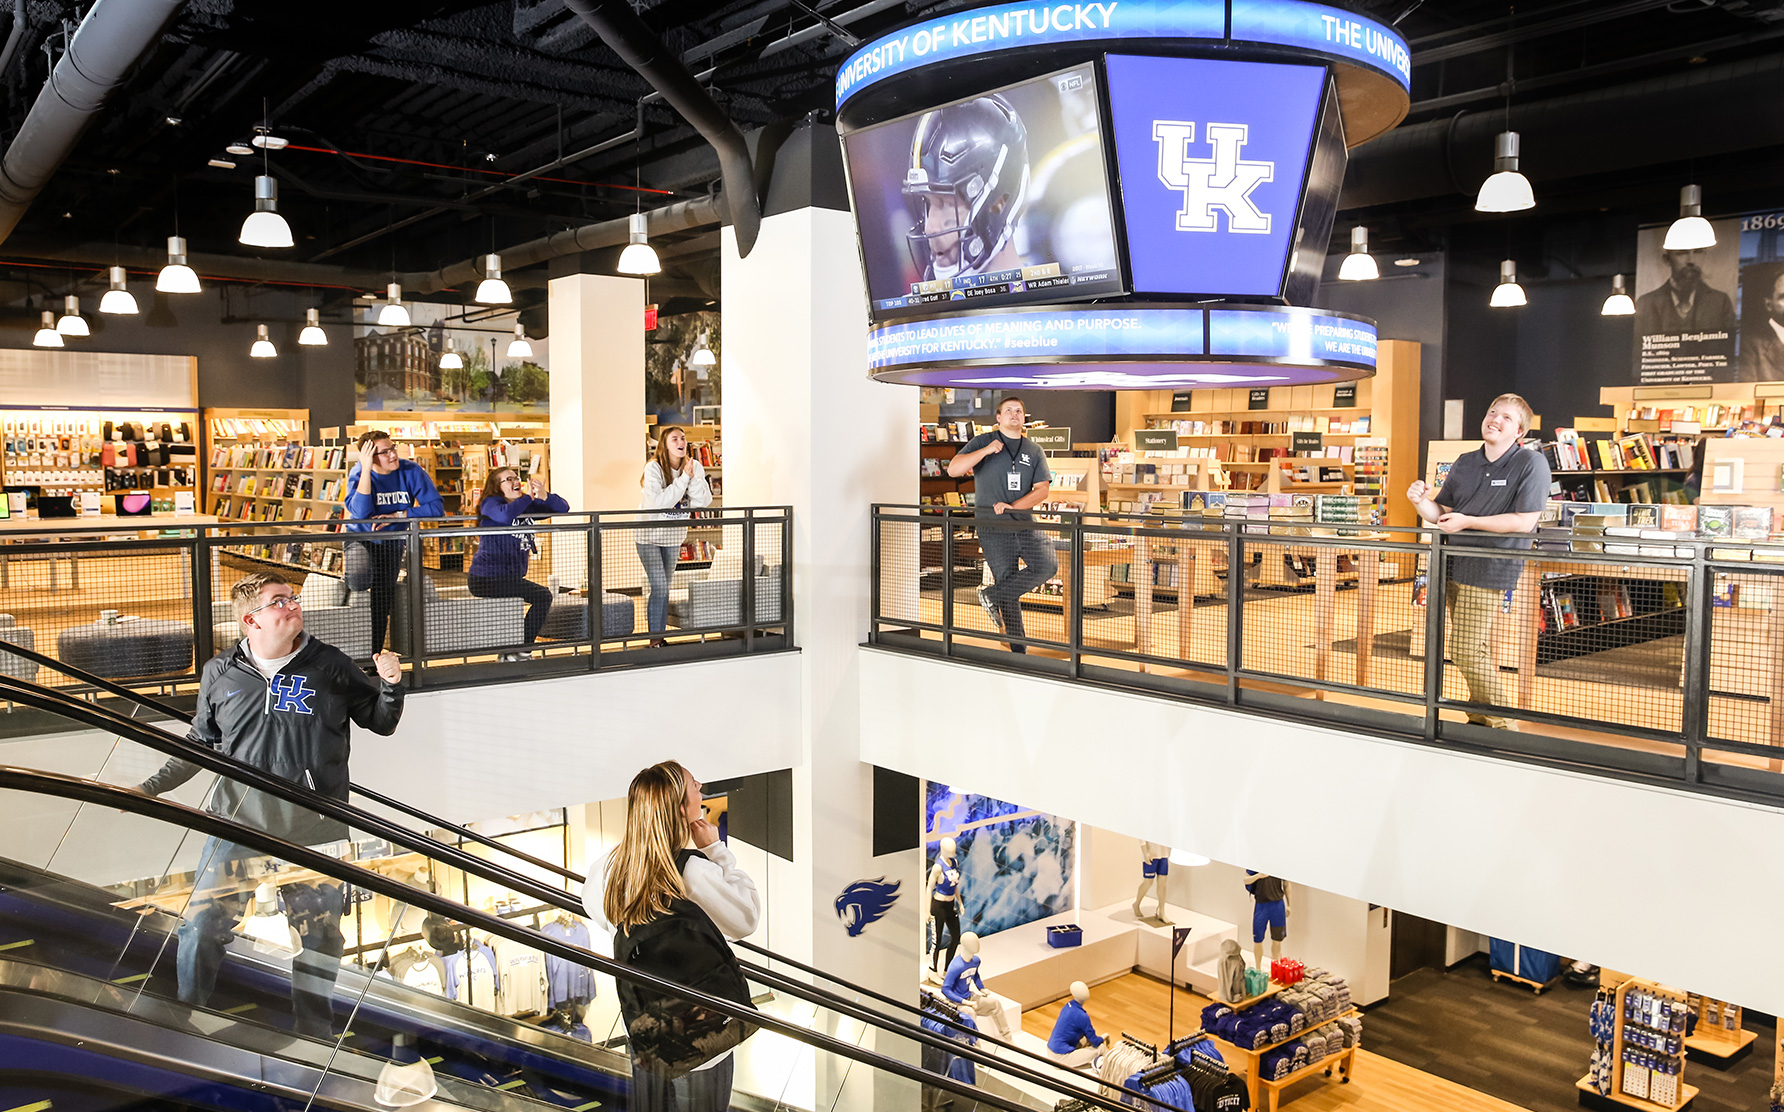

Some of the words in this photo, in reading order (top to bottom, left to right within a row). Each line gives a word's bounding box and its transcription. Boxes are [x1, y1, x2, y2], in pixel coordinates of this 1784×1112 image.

[1321, 14, 1362, 49] THE
[838, 36, 908, 98] UNIVERSITY
[912, 25, 946, 57] OF
[953, 2, 1118, 47] KENTUCKY
[1068, 78, 1081, 89] NFL
[1152, 119, 1275, 235] UK
[978, 275, 985, 284] 17
[1077, 273, 1108, 282] NETWORK
[1028, 281, 1037, 289] WR
[1038, 279, 1052, 287] Adam
[917, 327, 938, 340] LEAD
[940, 325, 965, 337] LIVES
[967, 323, 983, 335] OF
[985, 319, 1042, 334] MEANING
[1045, 318, 1074, 331] AND
[1077, 317, 1142, 331] PURPOSE.
[1642, 334, 1680, 343] William
[1681, 331, 1729, 342] Benjamin
[886, 344, 921, 359] UNIVERSITY
[921, 342, 939, 354] FOR
[1004, 335, 1058, 349] #seeblue
[1325, 340, 1338, 353] WE
[1338, 342, 1351, 354] ARE
[1642, 342, 1681, 350] Munson
[1054, 435, 1065, 443] Gifts
[1145, 438, 1167, 446] Stationery
[271, 673, 316, 715] UK
